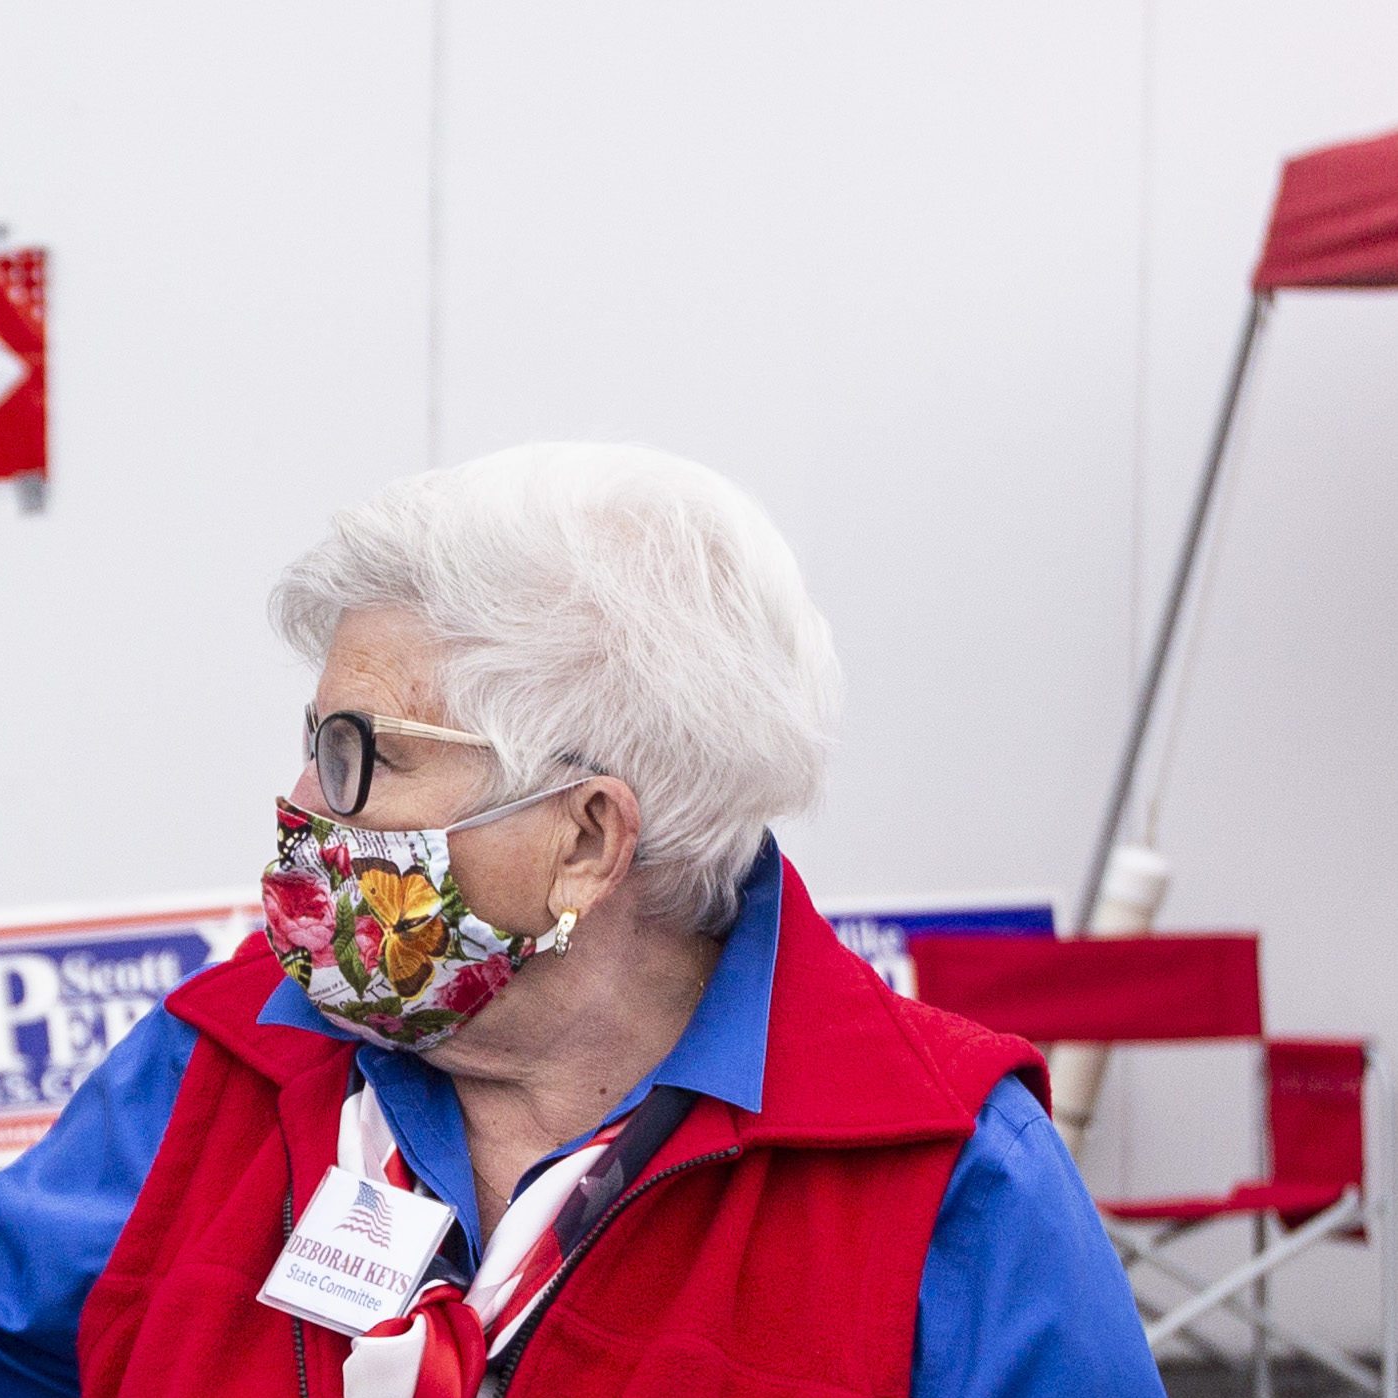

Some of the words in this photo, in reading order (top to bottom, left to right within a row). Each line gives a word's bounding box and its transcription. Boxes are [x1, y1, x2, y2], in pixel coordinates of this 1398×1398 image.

[286, 1263, 318, 1287] State
[318, 1275, 382, 1311] Committee
[287, 1235, 364, 1278] DEBORAH
[363, 1261, 412, 1295] KEYS
